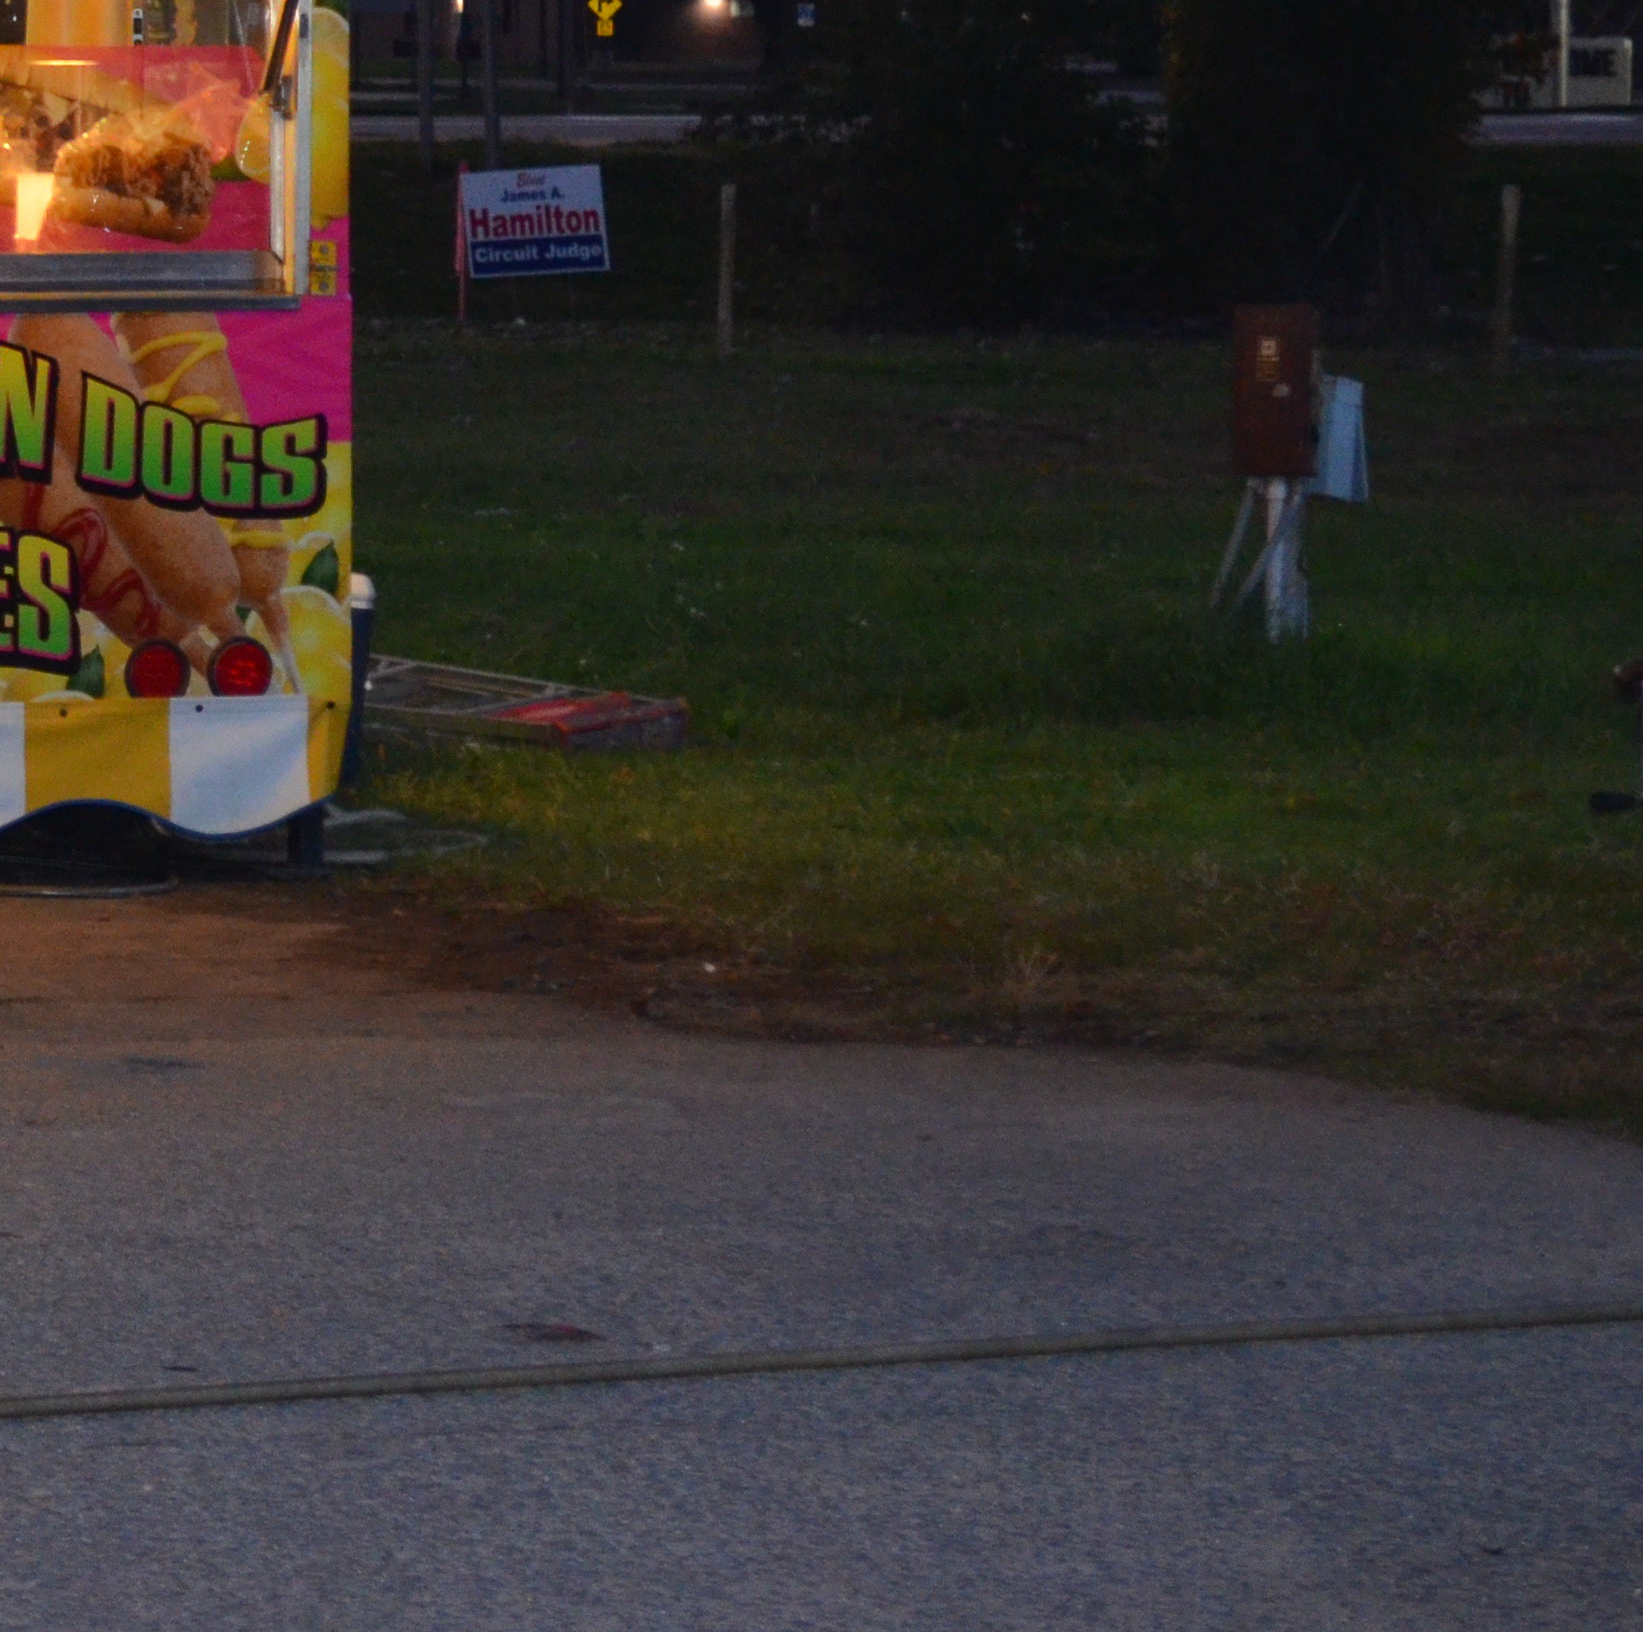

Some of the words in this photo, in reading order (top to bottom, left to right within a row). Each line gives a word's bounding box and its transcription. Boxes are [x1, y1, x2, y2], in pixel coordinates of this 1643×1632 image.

[500, 189, 547, 203] James
[469, 204, 600, 239] Hamilton
[473, 243, 540, 263] Circuit
[545, 242, 603, 262] Judge
[76, 370, 327, 519] DOGS
